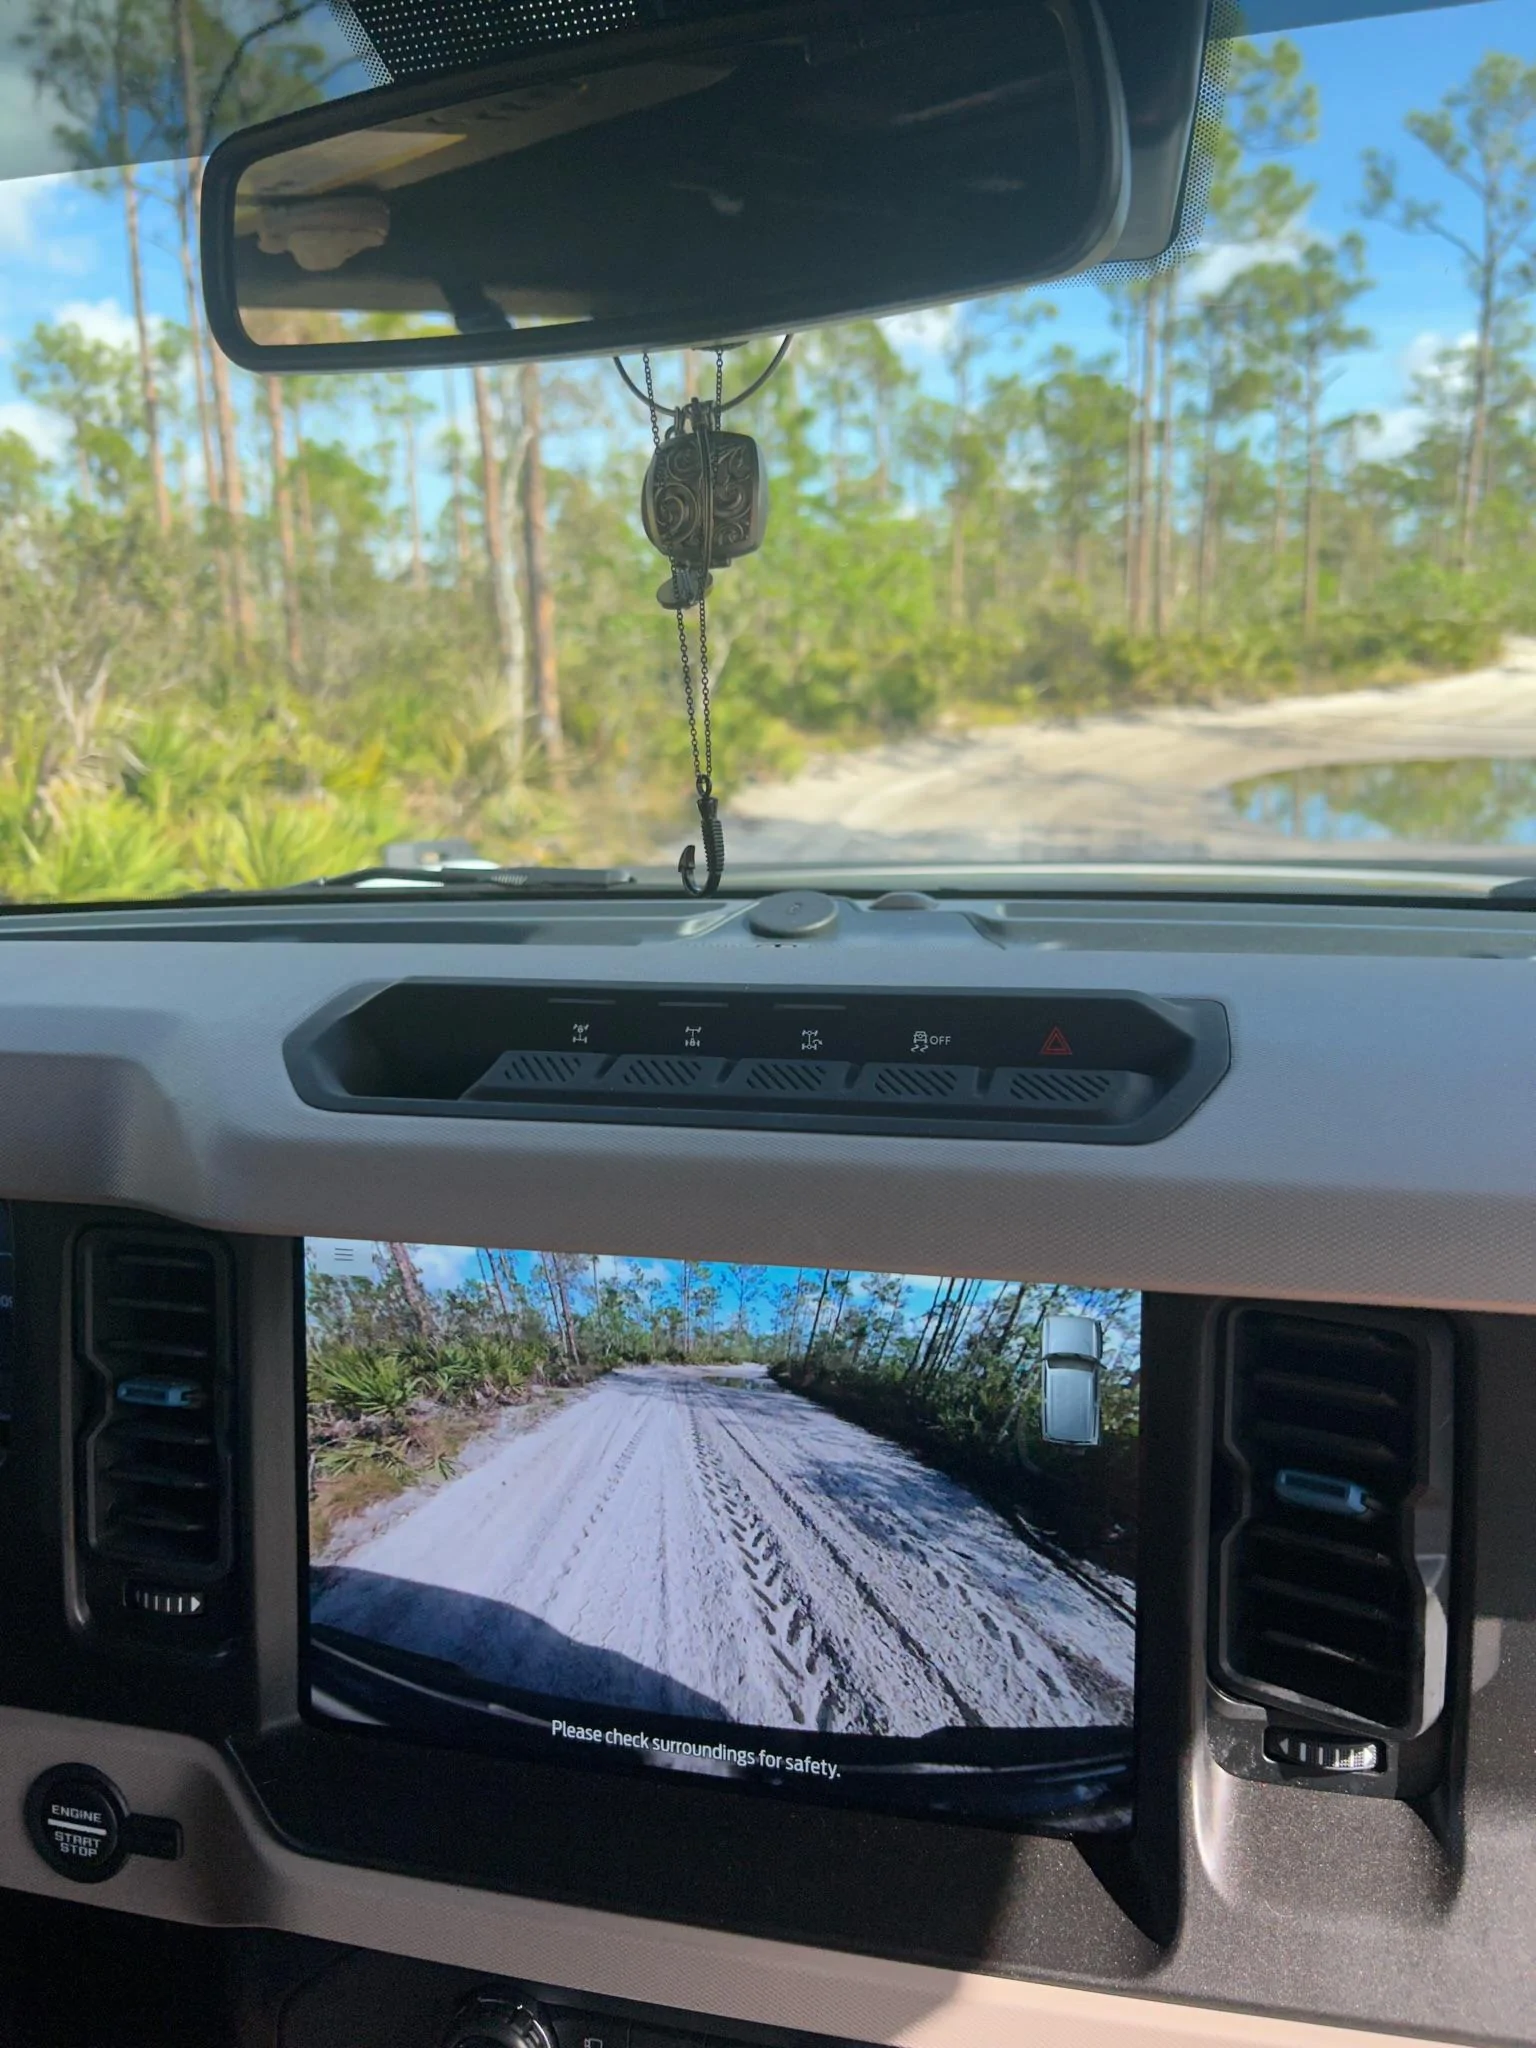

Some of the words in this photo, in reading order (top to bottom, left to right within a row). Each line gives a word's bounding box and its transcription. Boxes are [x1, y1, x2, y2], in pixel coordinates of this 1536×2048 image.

[929, 1035, 951, 1046] OFF
[551, 1719, 602, 1743] Please
[605, 1728, 649, 1750] check
[652, 1735, 755, 1767] surroundings
[759, 1749, 782, 1769] for
[785, 1755, 841, 1780] safety.
[51, 1804, 102, 1823] ENGINE
[54, 1831, 101, 1849] START
[60, 1842, 98, 1858] STOP
